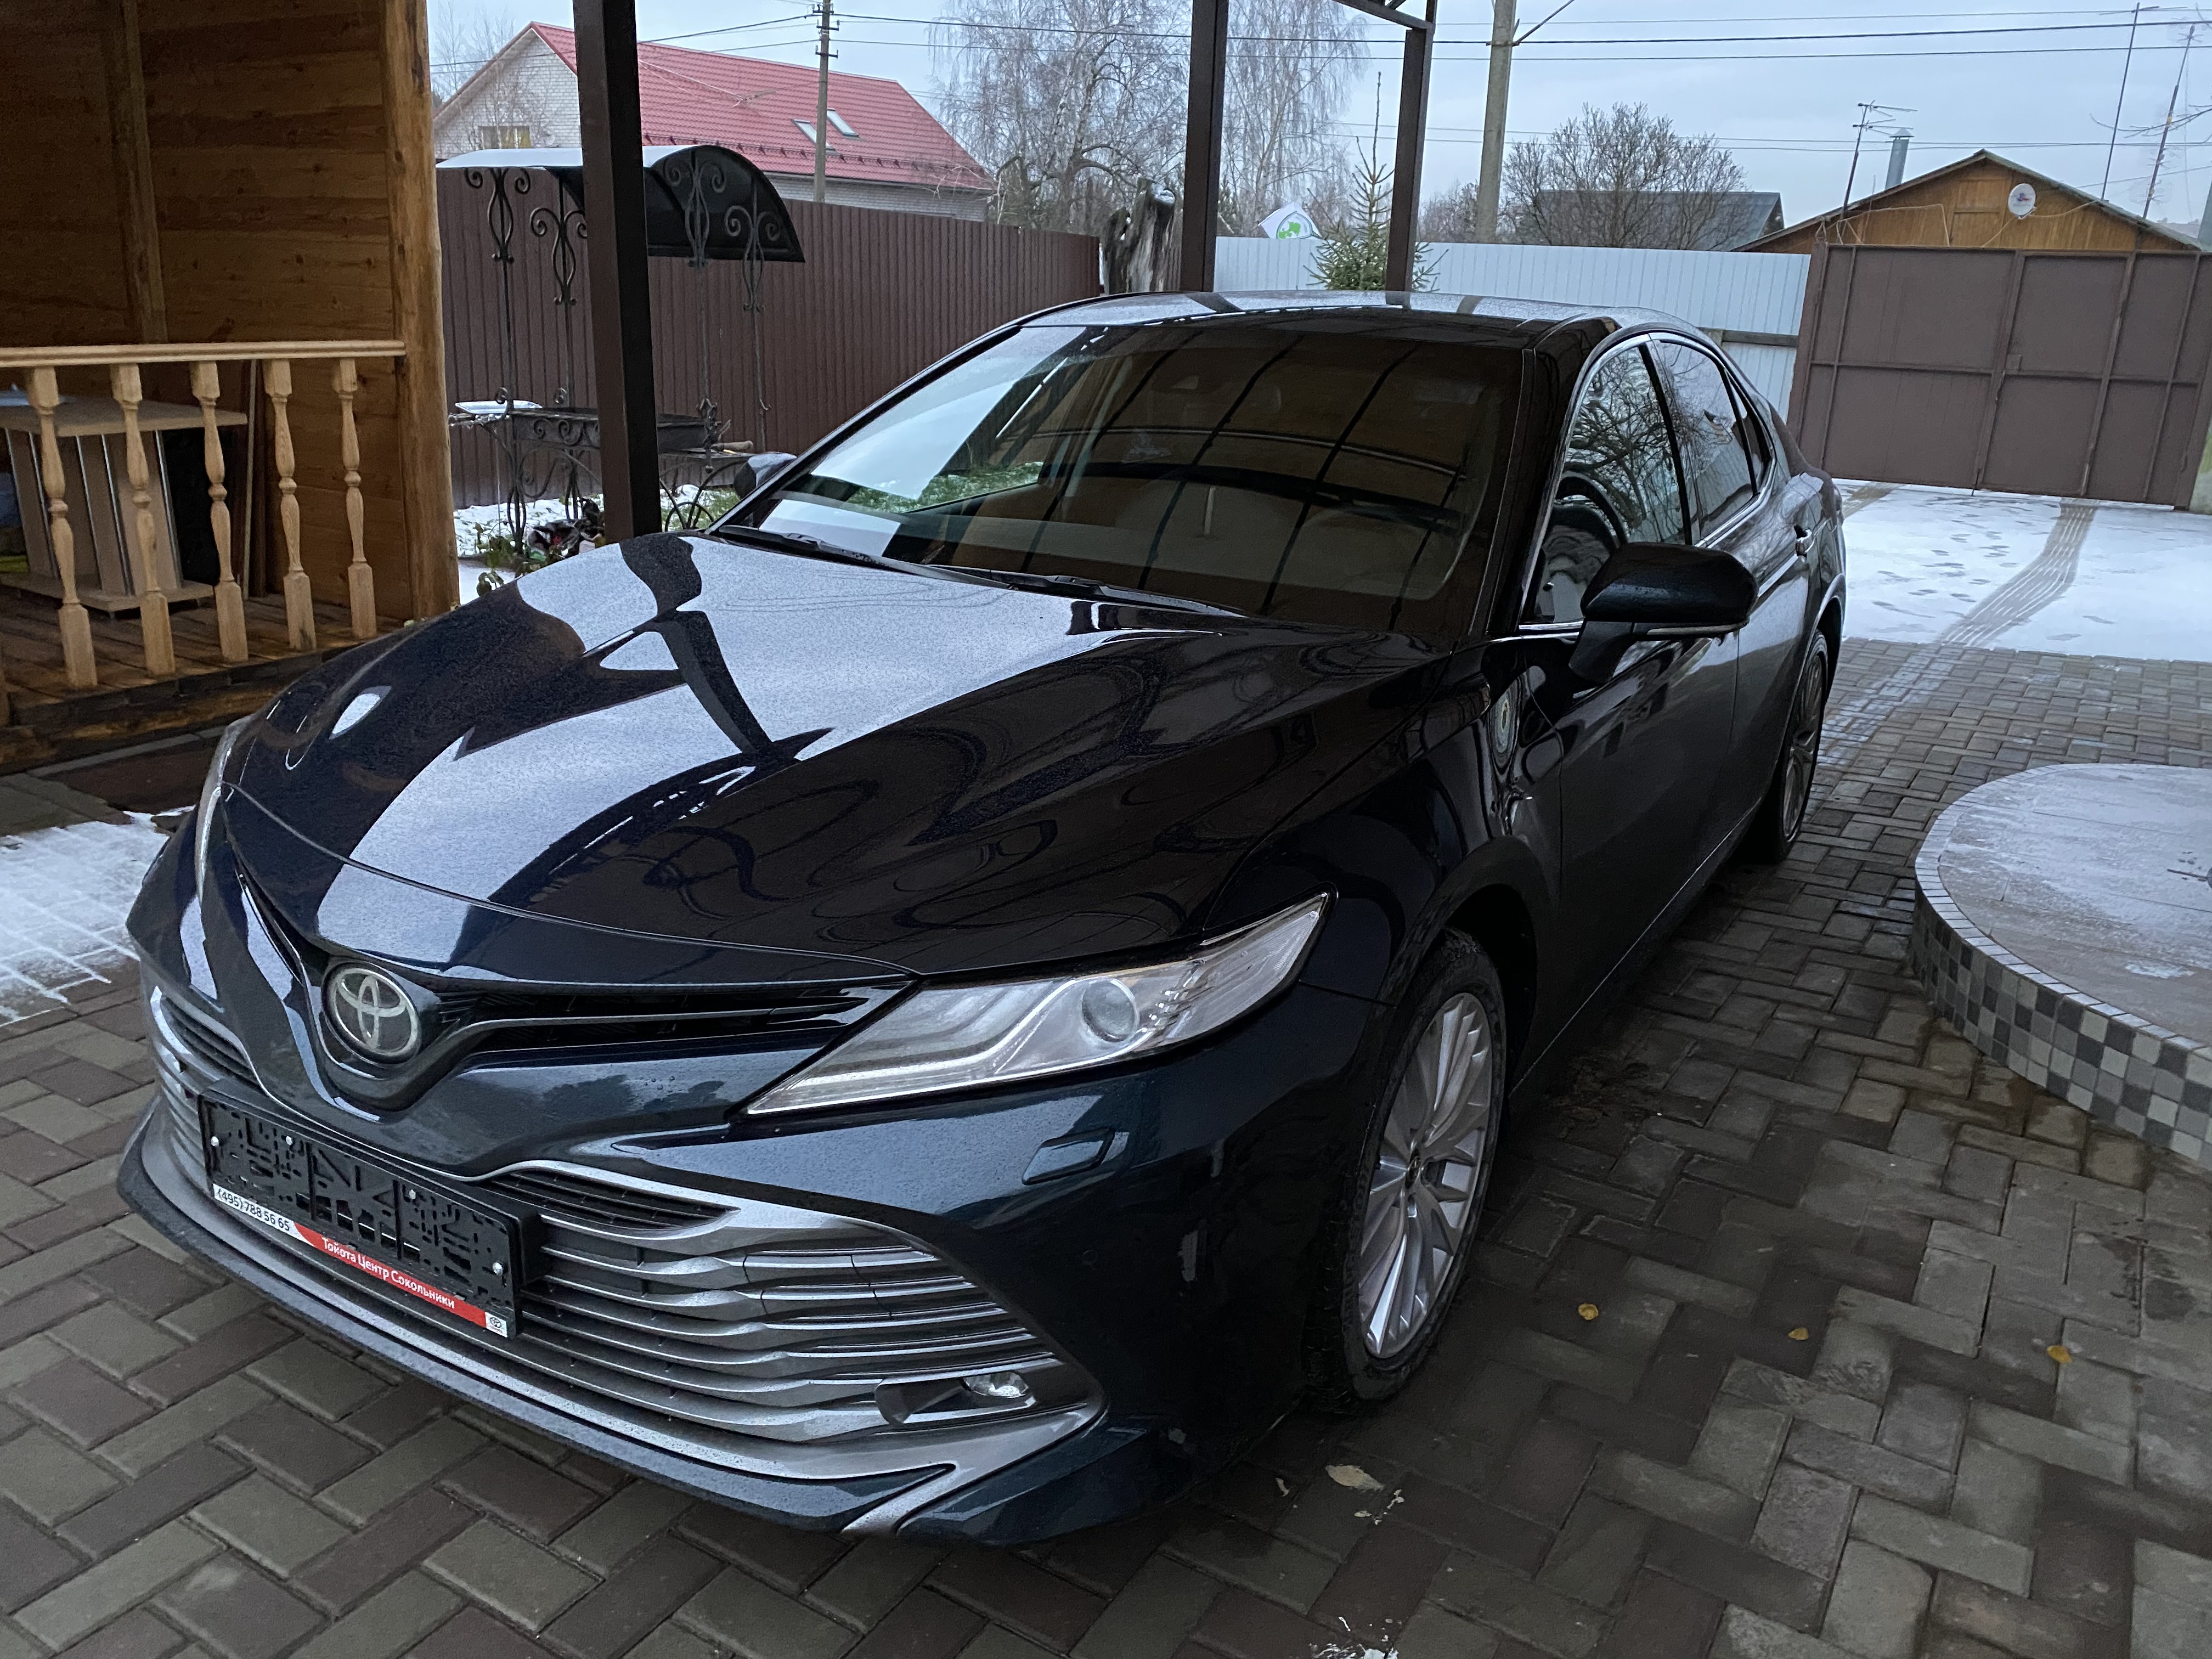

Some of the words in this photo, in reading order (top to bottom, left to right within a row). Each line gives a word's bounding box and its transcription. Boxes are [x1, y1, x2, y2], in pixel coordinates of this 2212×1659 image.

[218, 1188, 242, 1209] (495)
[244, 1201, 262, 1217] 788
[264, 1211, 275, 1224] 56
[278, 1218, 290, 1231] 65
[322, 1237, 356, 1262] Тойота
[358, 1252, 389, 1280] Центр
[391, 1270, 455, 1309] Сокольники
